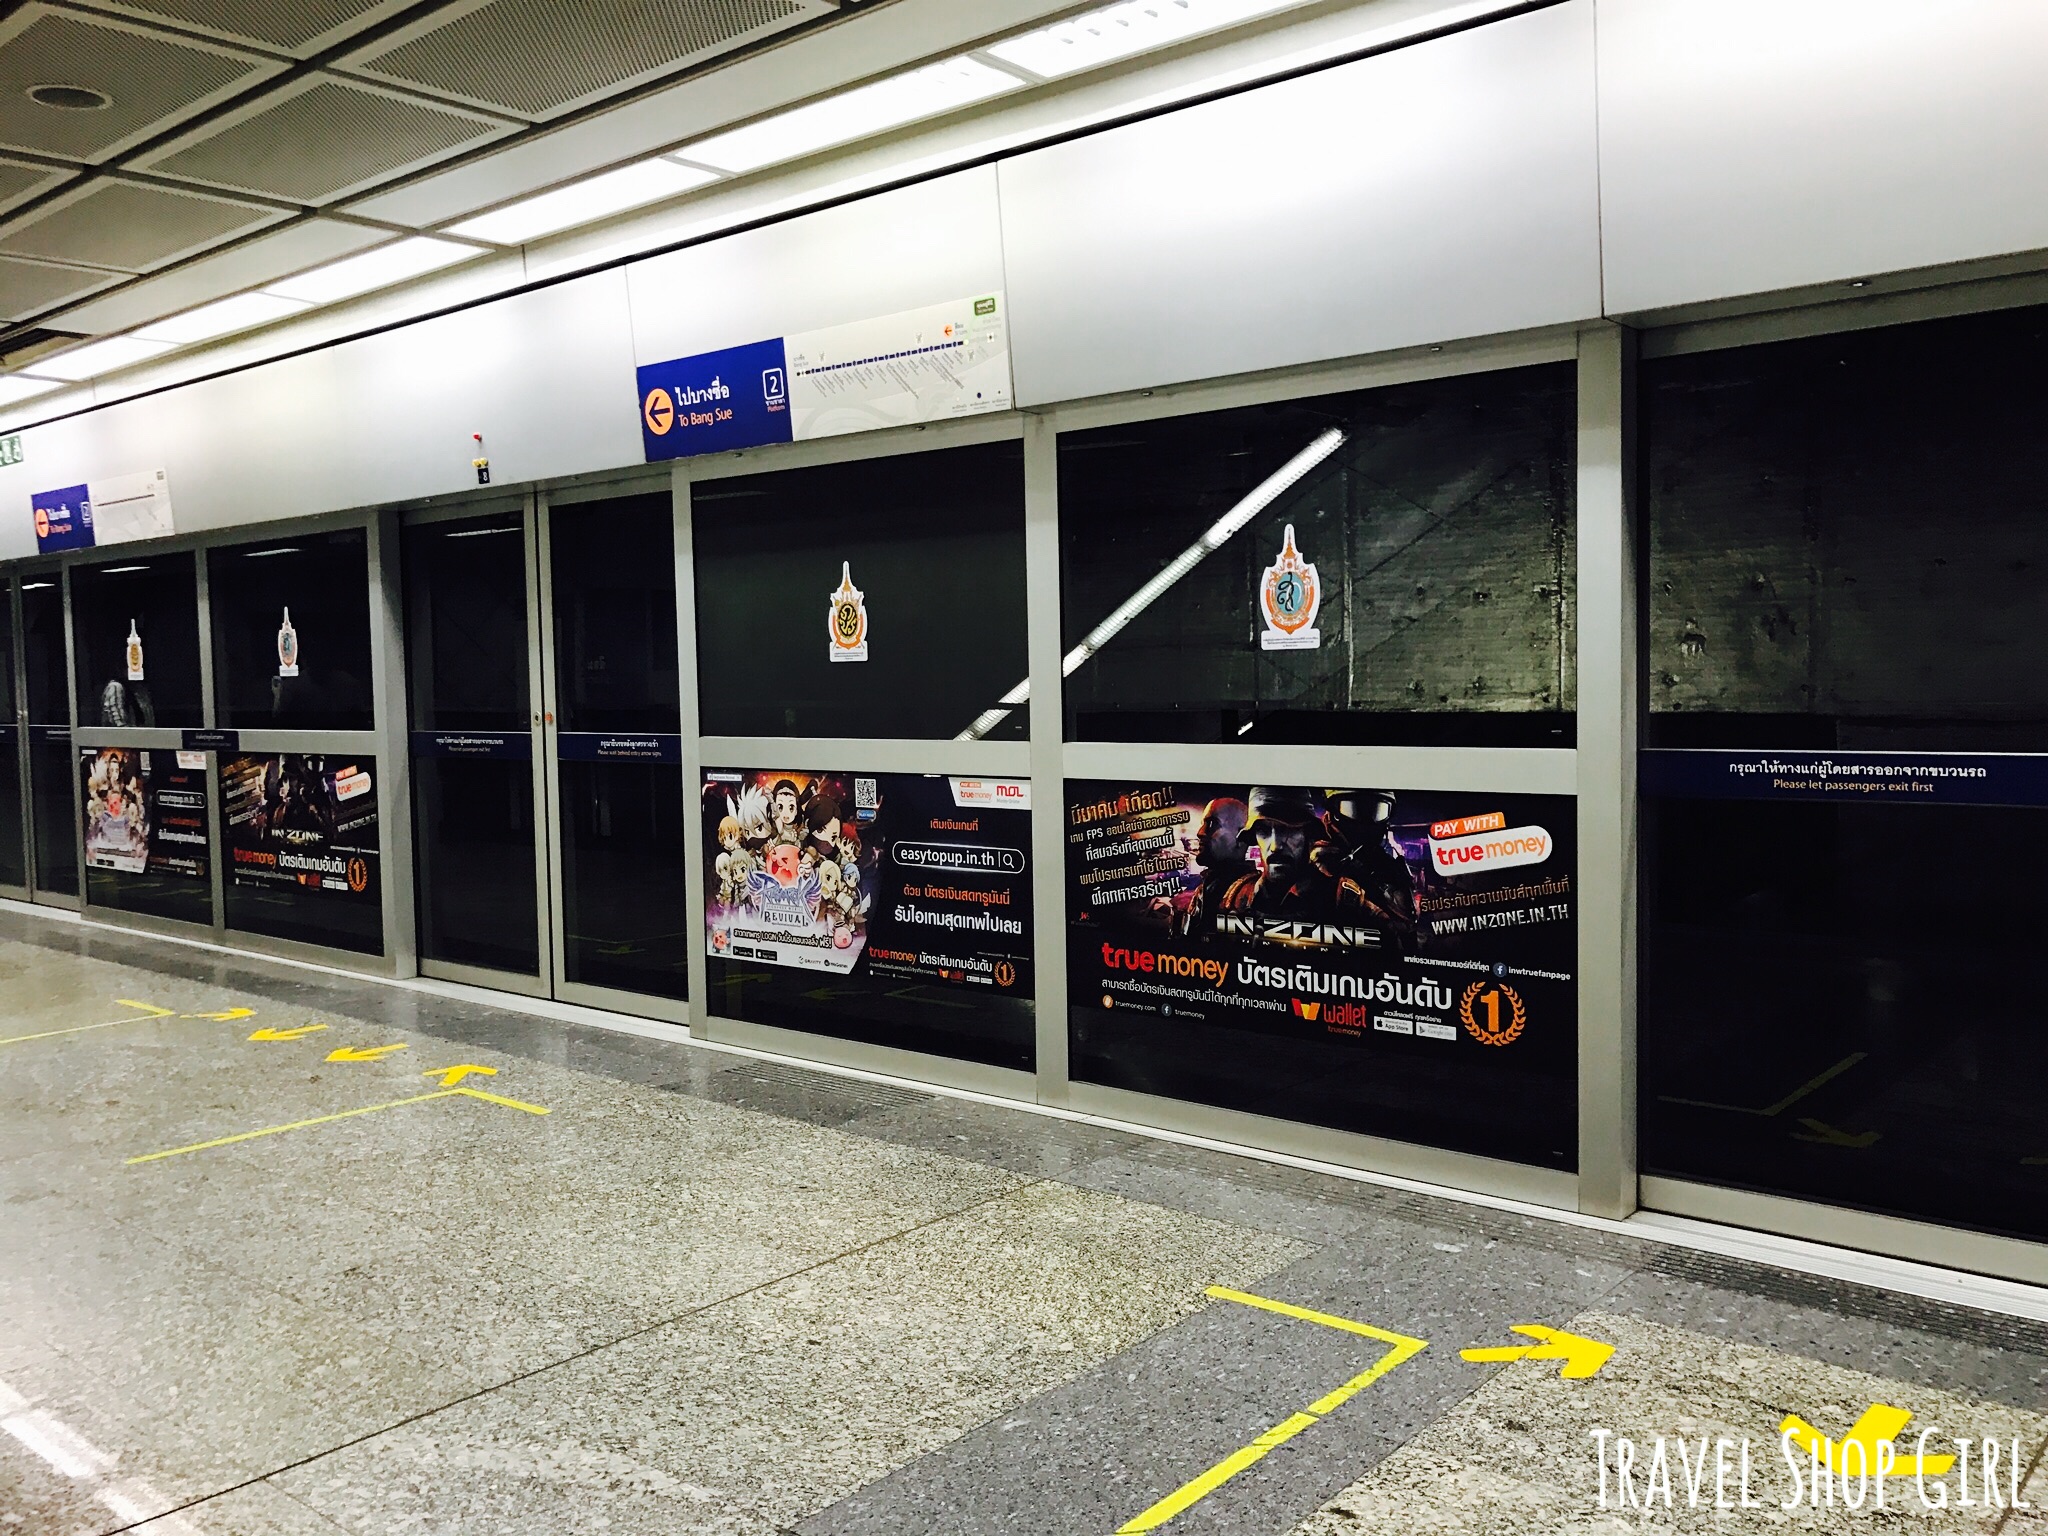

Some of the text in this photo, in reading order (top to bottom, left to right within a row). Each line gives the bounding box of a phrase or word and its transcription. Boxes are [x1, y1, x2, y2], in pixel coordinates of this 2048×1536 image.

[674, 375, 730, 406] ไปบางซื่อ
[769, 376, 778, 393] 2
[678, 408, 733, 427] To Bang Sue
[1729, 760, 1987, 779] กรุณาให้ทางแก่ผู้โดยสารออกจากขบวนรถ
[1773, 779, 1934, 793] Please let passengers exit first
[930, 818, 979, 832] เติมเงินเกมที่
[1434, 815, 1499, 837] PAY WITH
[1086, 828, 1104, 841] FPS
[900, 849, 995, 867] easytopup.in.th
[903, 884, 921, 897] ด้วย
[894, 904, 1022, 935] รับไอเทมสุดเทพไปเลย
[1431, 904, 1569, 935] WWW.INZONE.IN.TH
[1508, 966, 1571, 981] inwtruefanpage
[1237, 956, 1452, 1010] บัตรเติมเกมอันดับ
[1115, 1000, 1157, 1012] truemoney.com
[1174, 1008, 1206, 1020] truemoney
[1323, 1002, 1367, 1028] wallet
[1480, 990, 1499, 1032] 1
